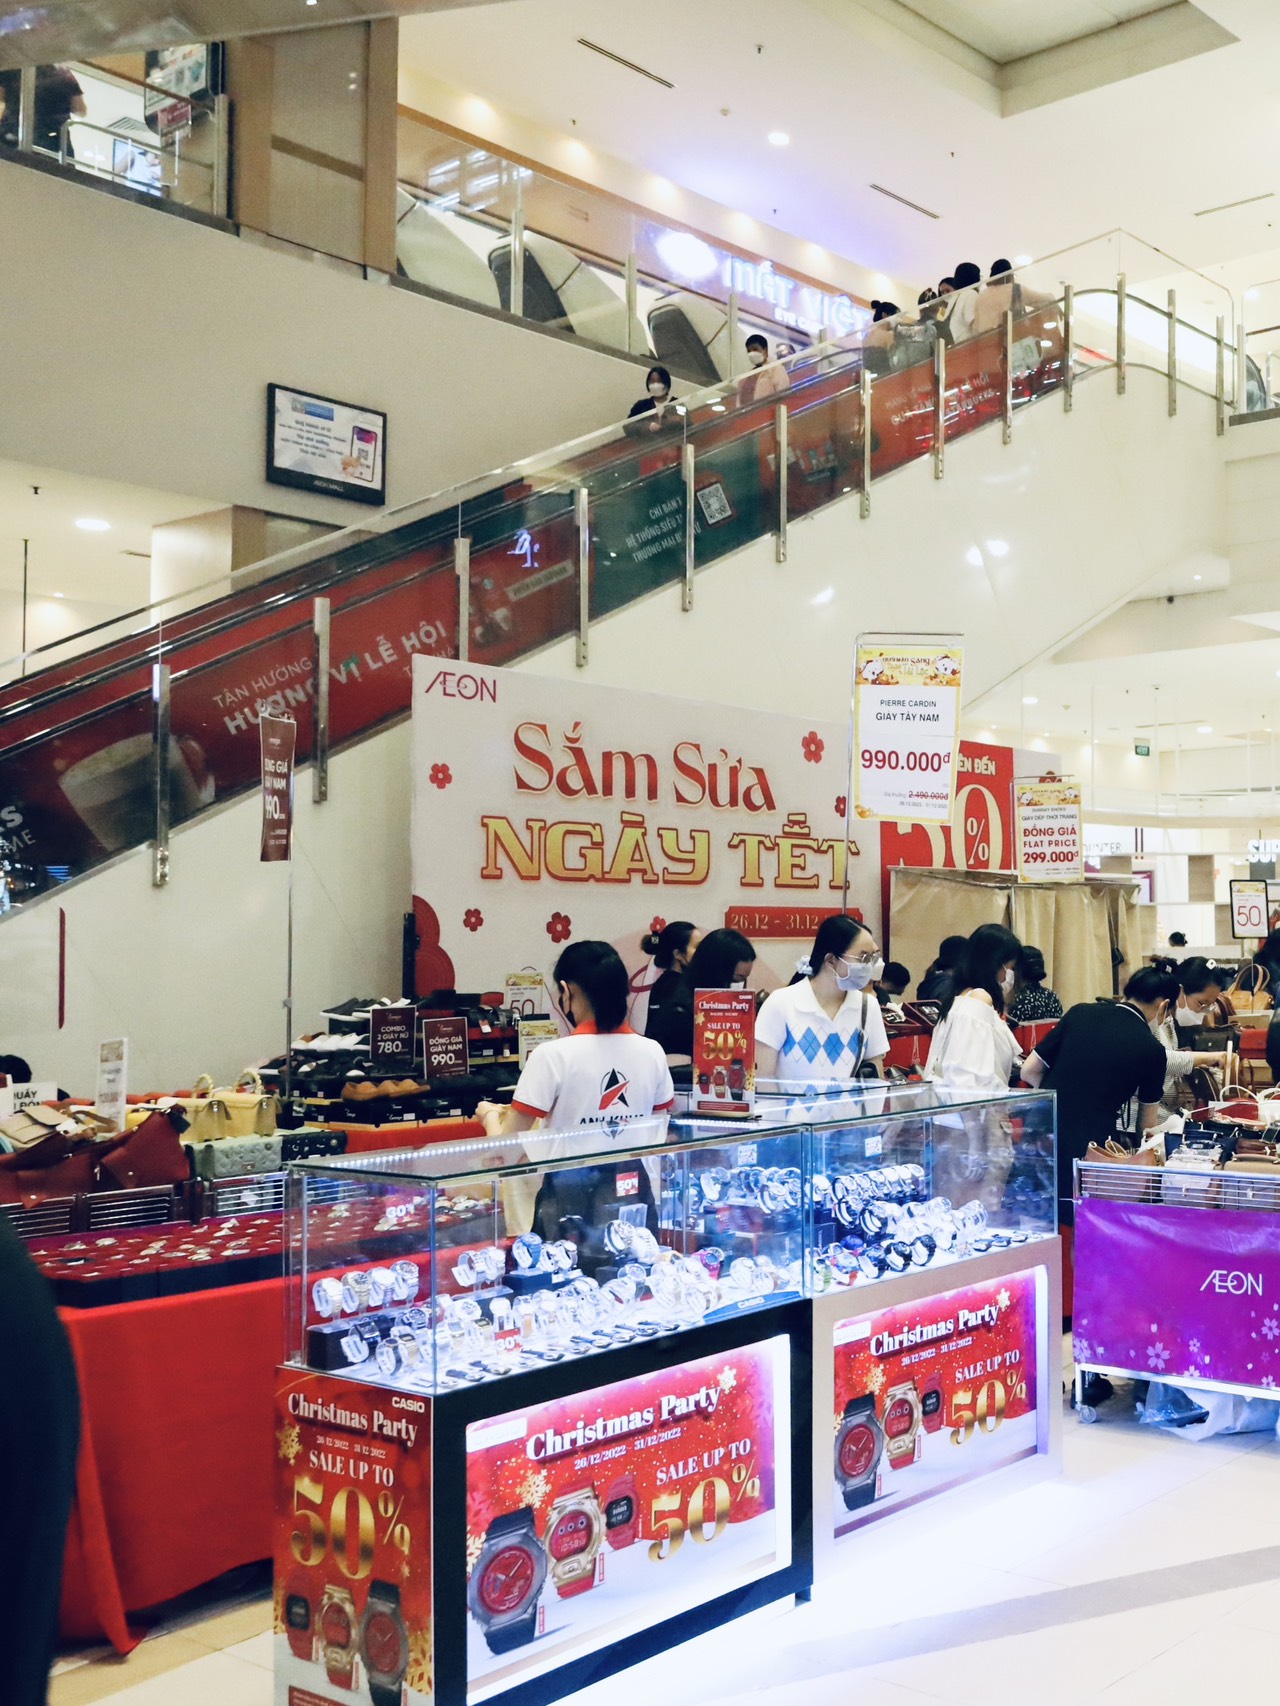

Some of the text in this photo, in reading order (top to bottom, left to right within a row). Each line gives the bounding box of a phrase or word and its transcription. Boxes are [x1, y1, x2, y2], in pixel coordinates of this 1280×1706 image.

[401, 620, 446, 654] HỘI
[880, 699, 937, 708] PIERRE CARDIN
[919, 713, 940, 722] NAM
[513, 721, 777, 814] Sắm Sửa
[957, 753, 996, 776] ÊN ĐẾN
[1023, 823, 1077, 838] ĐỒNG GIÁ
[1023, 838, 1077, 848] FLAT PRICE
[481, 811, 860, 890] NGÀY TẾT
[731, 913, 768, 929] 26.12
[699, 1001, 749, 1011] Christmas Party
[707, 1022, 741, 1030] SALE UP TO
[703, 1030, 747, 1060] 50%
[870, 1303, 1000, 1357] Christmas Party
[955, 1349, 1021, 1384] SALE UP TO
[288, 1393, 418, 1447] Christmas Party
[392, 1397, 425, 1413] CASIO
[950, 1367, 1027, 1446] 50%
[525, 1407, 655, 1461] Christmas
[660, 1386, 722, 1421] Party
[574, 1427, 682, 1470] 26/12/2022 31/12/2022
[656, 1438, 751, 1486] SALE UP TO
[309, 1449, 394, 1487] SALE UP TO
[648, 1456, 761, 1563] 50%
[290, 1475, 411, 1580] 50%
